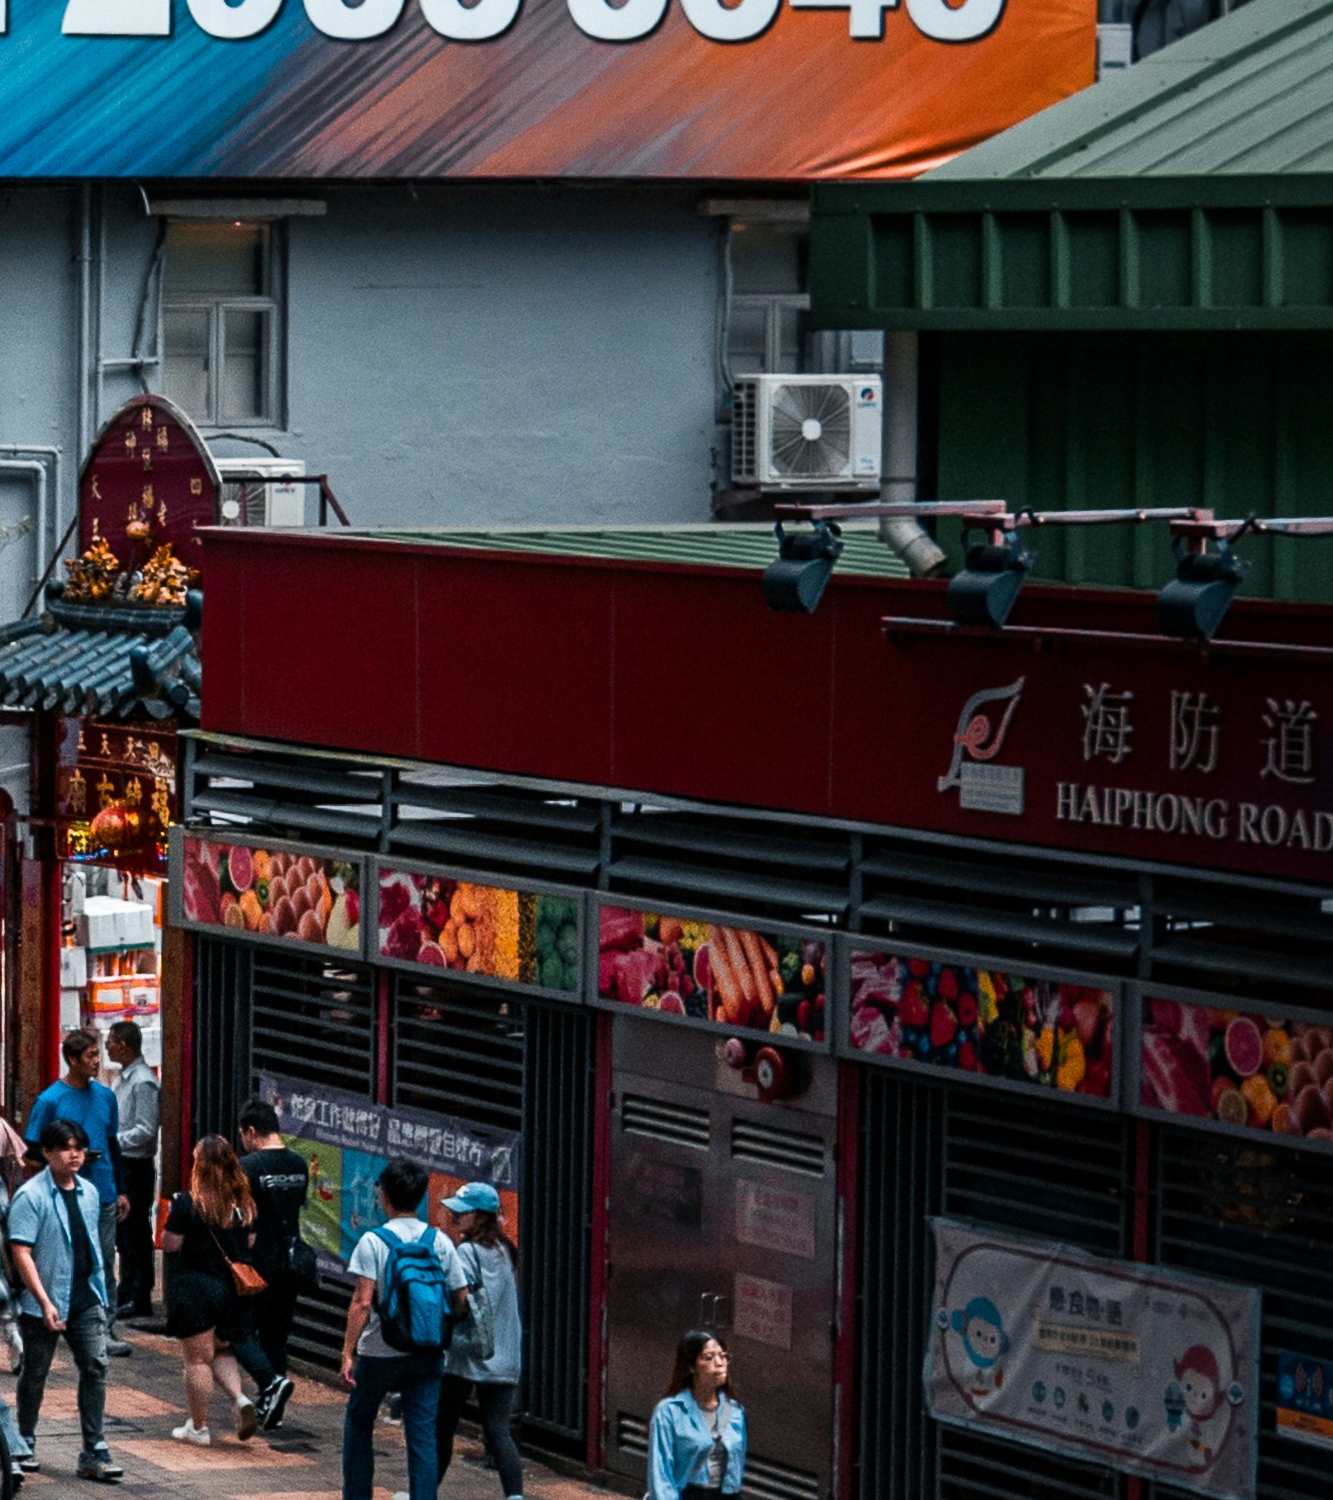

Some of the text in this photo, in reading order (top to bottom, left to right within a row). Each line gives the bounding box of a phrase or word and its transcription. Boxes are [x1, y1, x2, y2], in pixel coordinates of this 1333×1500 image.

[1080, 681, 1319, 785] 海防道
[1055, 781, 1333, 853] HAIPHONG ROAD
